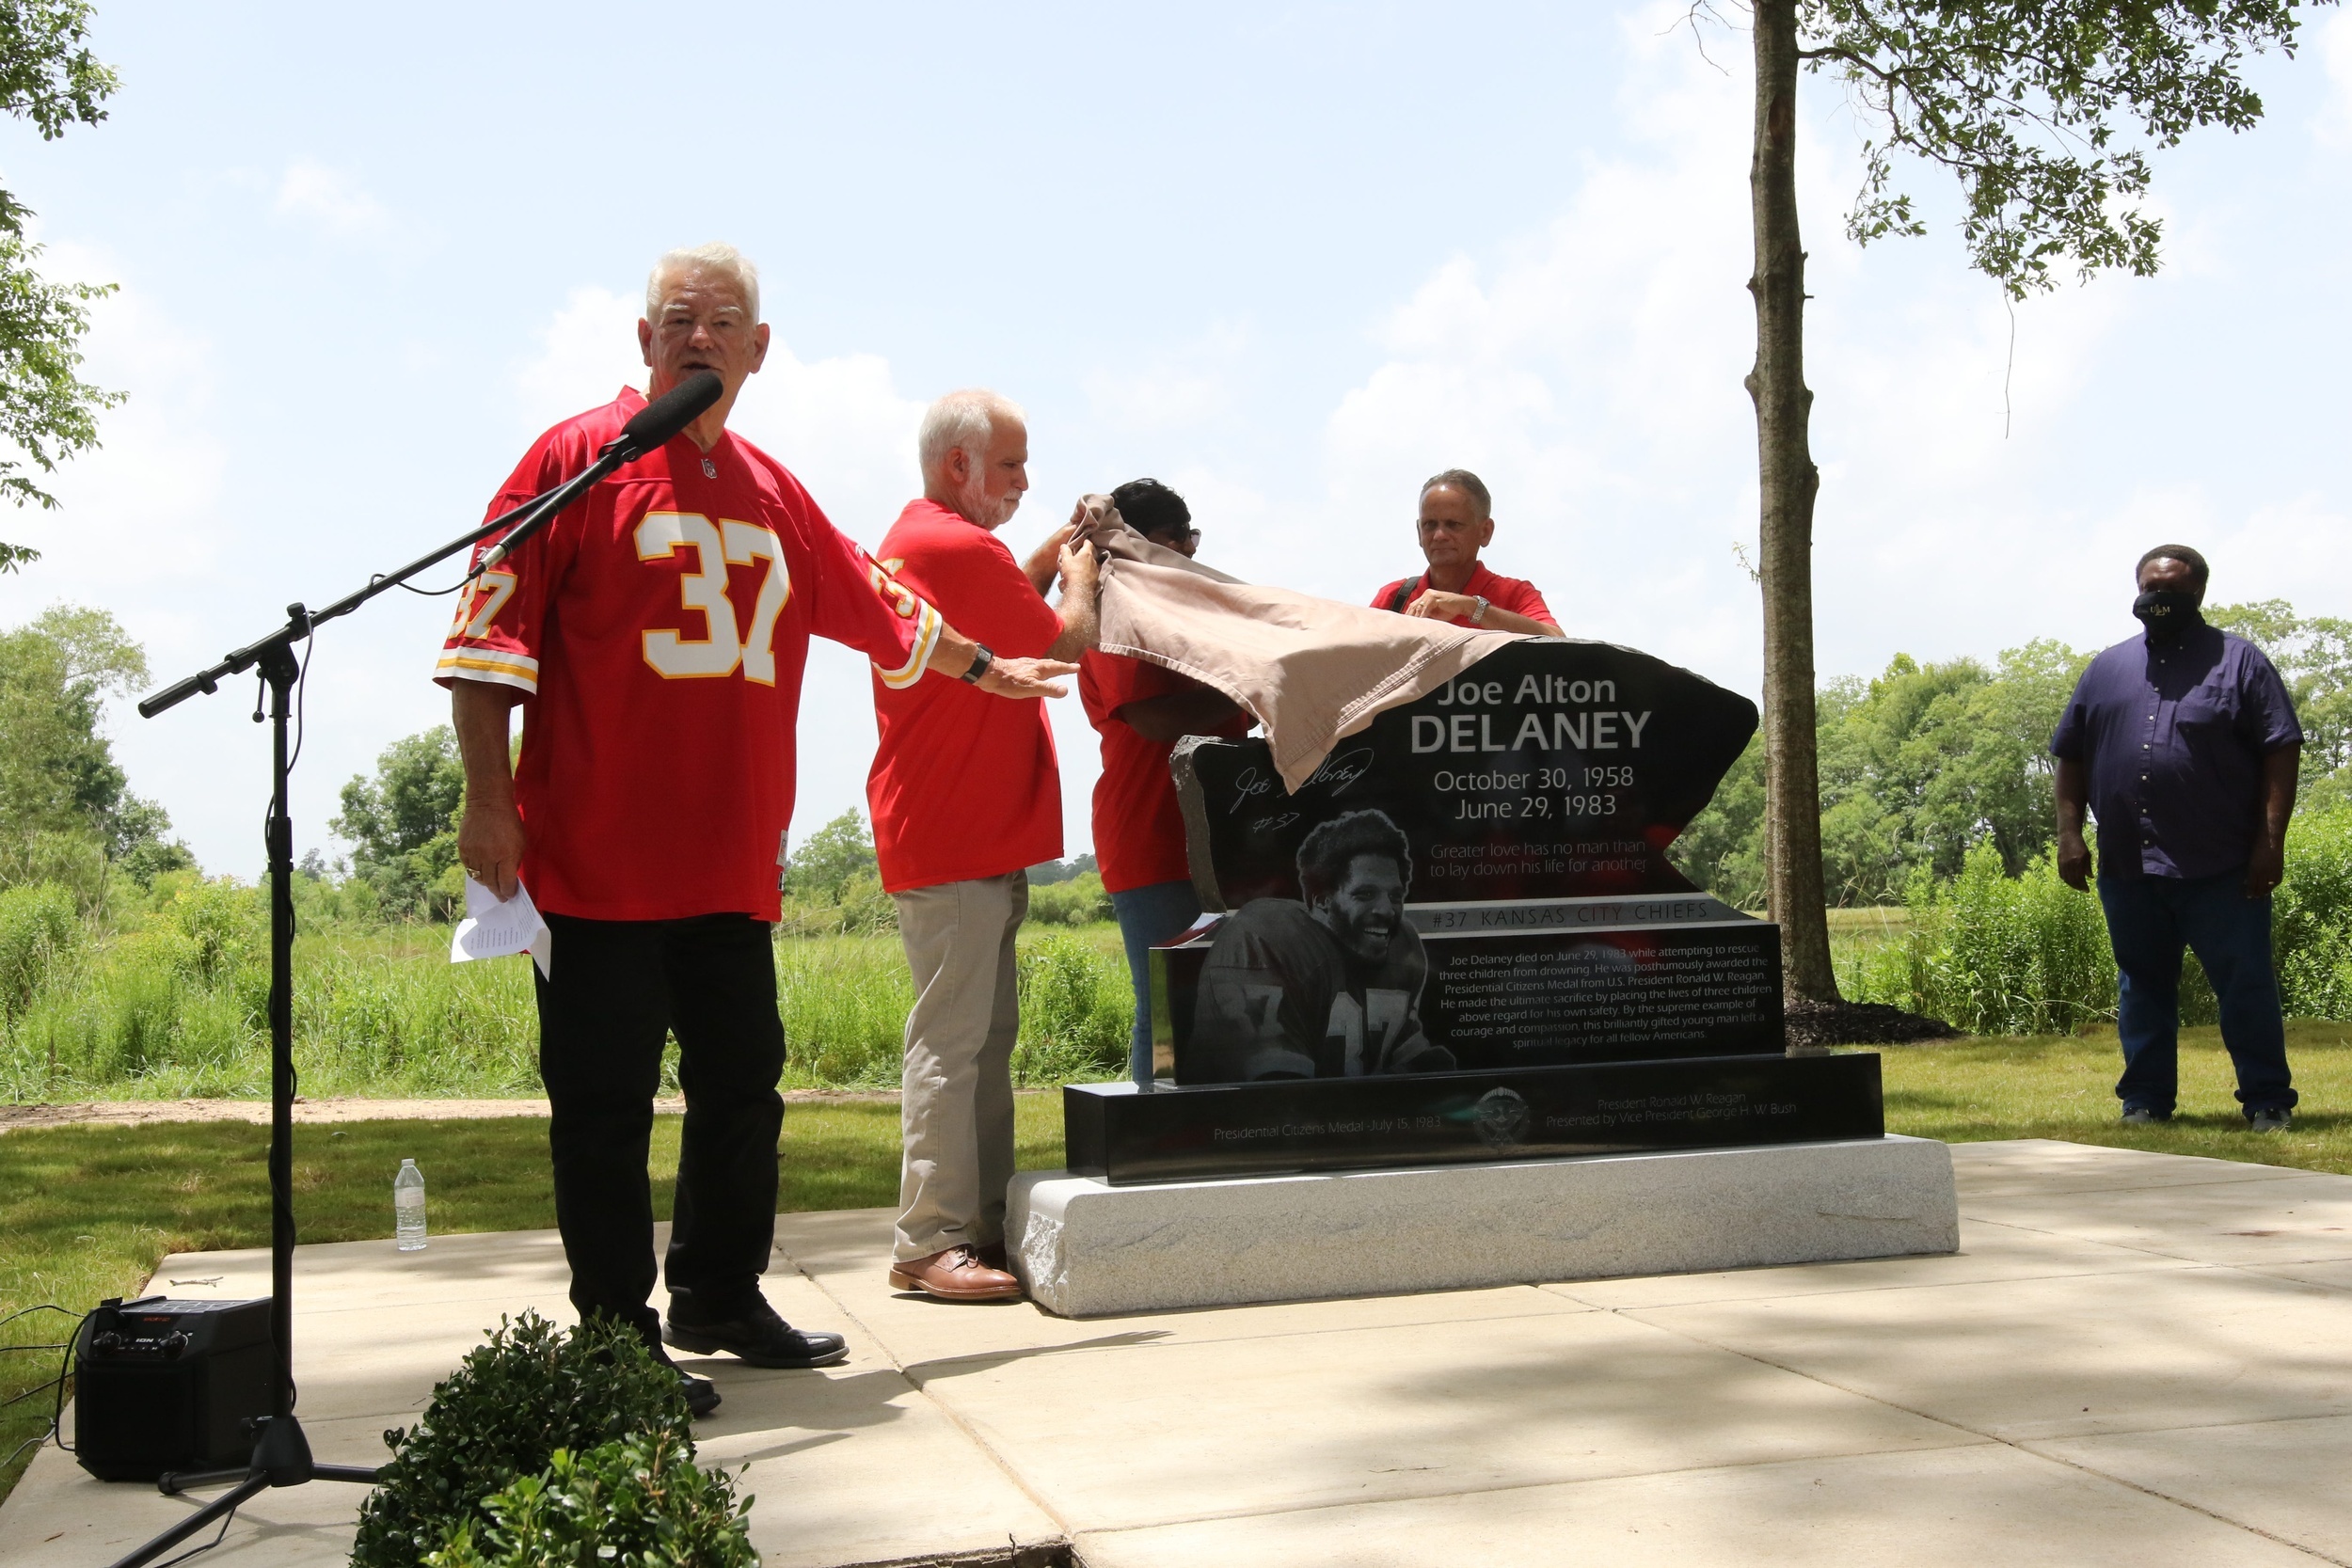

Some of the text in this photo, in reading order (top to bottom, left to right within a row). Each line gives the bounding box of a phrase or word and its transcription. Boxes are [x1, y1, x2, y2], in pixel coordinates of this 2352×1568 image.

[633, 512, 790, 688] 37
[1438, 673, 1616, 705] Joe Alton
[1411, 711, 1652, 753] DELANEY
[1434, 766, 1634, 792] October 30, 1958
[1454, 794, 1617, 820] June 29, 1983
[1252, 812, 1300, 834] #37
[1430, 839, 1646, 859] Greater love has no man than
[1429, 863, 1445, 878] to
[1449, 863, 1470, 880] lay
[1472, 862, 1517, 876] down
[1520, 860, 1541, 875] his
[1545, 859, 1565, 874] life
[1568, 858, 1590, 873] for
[1432, 901, 1708, 928] #37 KANSAS CITY CHIEFS
[1450, 944, 1759, 967] Joe Delaney died on June 29, 1983 while attempting to rescue
[1439, 971, 1467, 981] three
[1469, 969, 1511, 980] children
[1513, 967, 1537, 978] from
[1595, 963, 1610, 974] He
[1612, 963, 1632, 973] was
[1634, 959, 1705, 974] posthumously
[1706, 958, 1750, 969] awarded
[1752, 957, 1769, 967] the
[1445, 971, 1768, 995] Presidential Citizens Medal from U.S. President Ronald W. Reagan.
[1440, 984, 1773, 1010] He made the ultimate sacrifice by placing the lives of three children
[1458, 1011, 1491, 1023] above
[1493, 1009, 1528, 1022] regard
[1530, 1008, 1544, 1020] for
[1547, 1007, 1562, 1019] his
[1563, 1008, 1587, 1018] own
[1623, 1004, 1636, 1017] By
[1638, 1003, 1656, 1014] the
[1657, 1003, 1701, 1016] supreme
[1702, 999, 1744, 1013] example
[1745, 998, 1757, 1009] of
[1451, 1027, 1493, 1038] courage
[1495, 1024, 1517, 1035] and
[1582, 1020, 1602, 1031] this
[1603, 1018, 1649, 1031] brilliantly
[1650, 1016, 1680, 1030] gifted
[1681, 1015, 1715, 1028] young
[1716, 1014, 1740, 1024] man
[1740, 1012, 1757, 1023] left
[1758, 1013, 1766, 1022] a
[1513, 1029, 1708, 1051] spiritual legacy for all fellow Americans.
[1546, 1114, 1600, 1128] Presented
[1602, 1113, 1617, 1127] by
[1618, 1110, 1643, 1123] Vice
[1645, 1108, 1694, 1122] President
[1696, 1105, 1738, 1120] George
[1771, 1101, 1798, 1115] Bush
[1597, 1098, 1646, 1111] President
[1649, 1095, 1688, 1108] Ronald
[1706, 1092, 1747, 1106] Reagan
[1214, 1125, 1279, 1141] Presidential
[1281, 1122, 1326, 1137] Citizens
[1327, 1120, 1364, 1133] Medal
[1415, 1115, 1442, 1129] 1983
